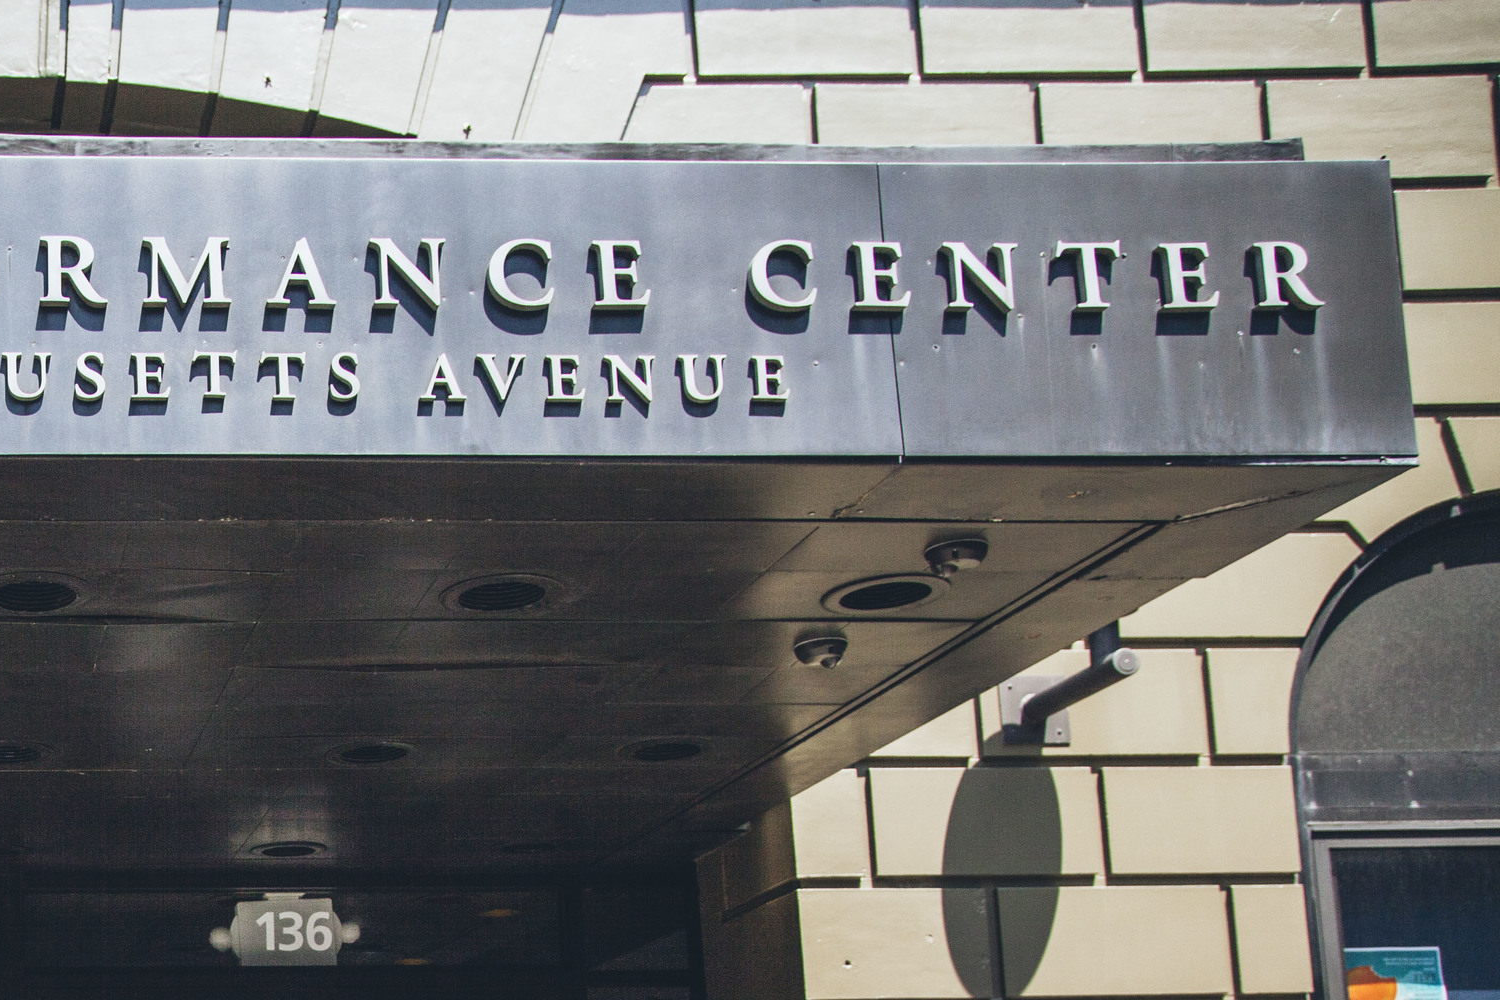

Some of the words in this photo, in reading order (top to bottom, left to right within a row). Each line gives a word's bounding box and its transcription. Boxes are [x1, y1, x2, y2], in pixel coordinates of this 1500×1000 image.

[748, 239, 1326, 313] CENTER
[418, 352, 791, 404] AVENUE
[255, 911, 333, 951] 136
